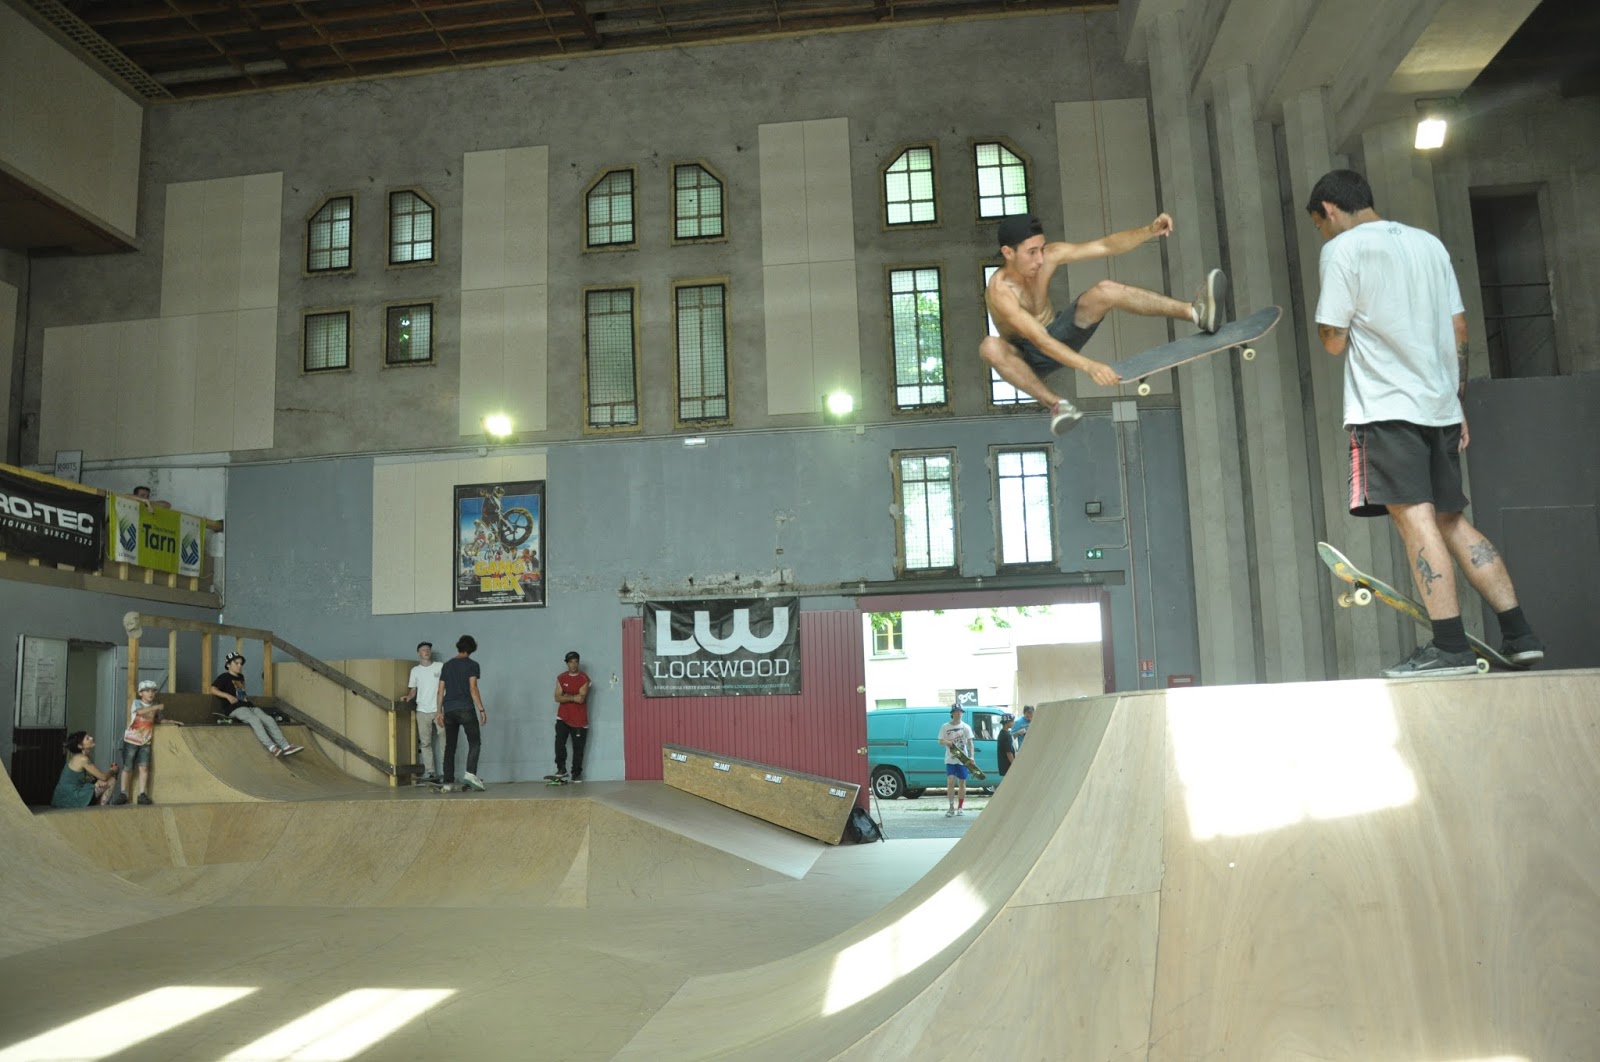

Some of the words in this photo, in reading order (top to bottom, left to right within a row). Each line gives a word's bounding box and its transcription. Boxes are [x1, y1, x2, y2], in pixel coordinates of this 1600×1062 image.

[44, 528, 70, 540] SINCE
[143, 523, 176, 554] Tarn
[474, 560, 525, 576] GANG
[480, 576, 526, 595] BMX
[653, 658, 790, 679] LOCKWOOD
